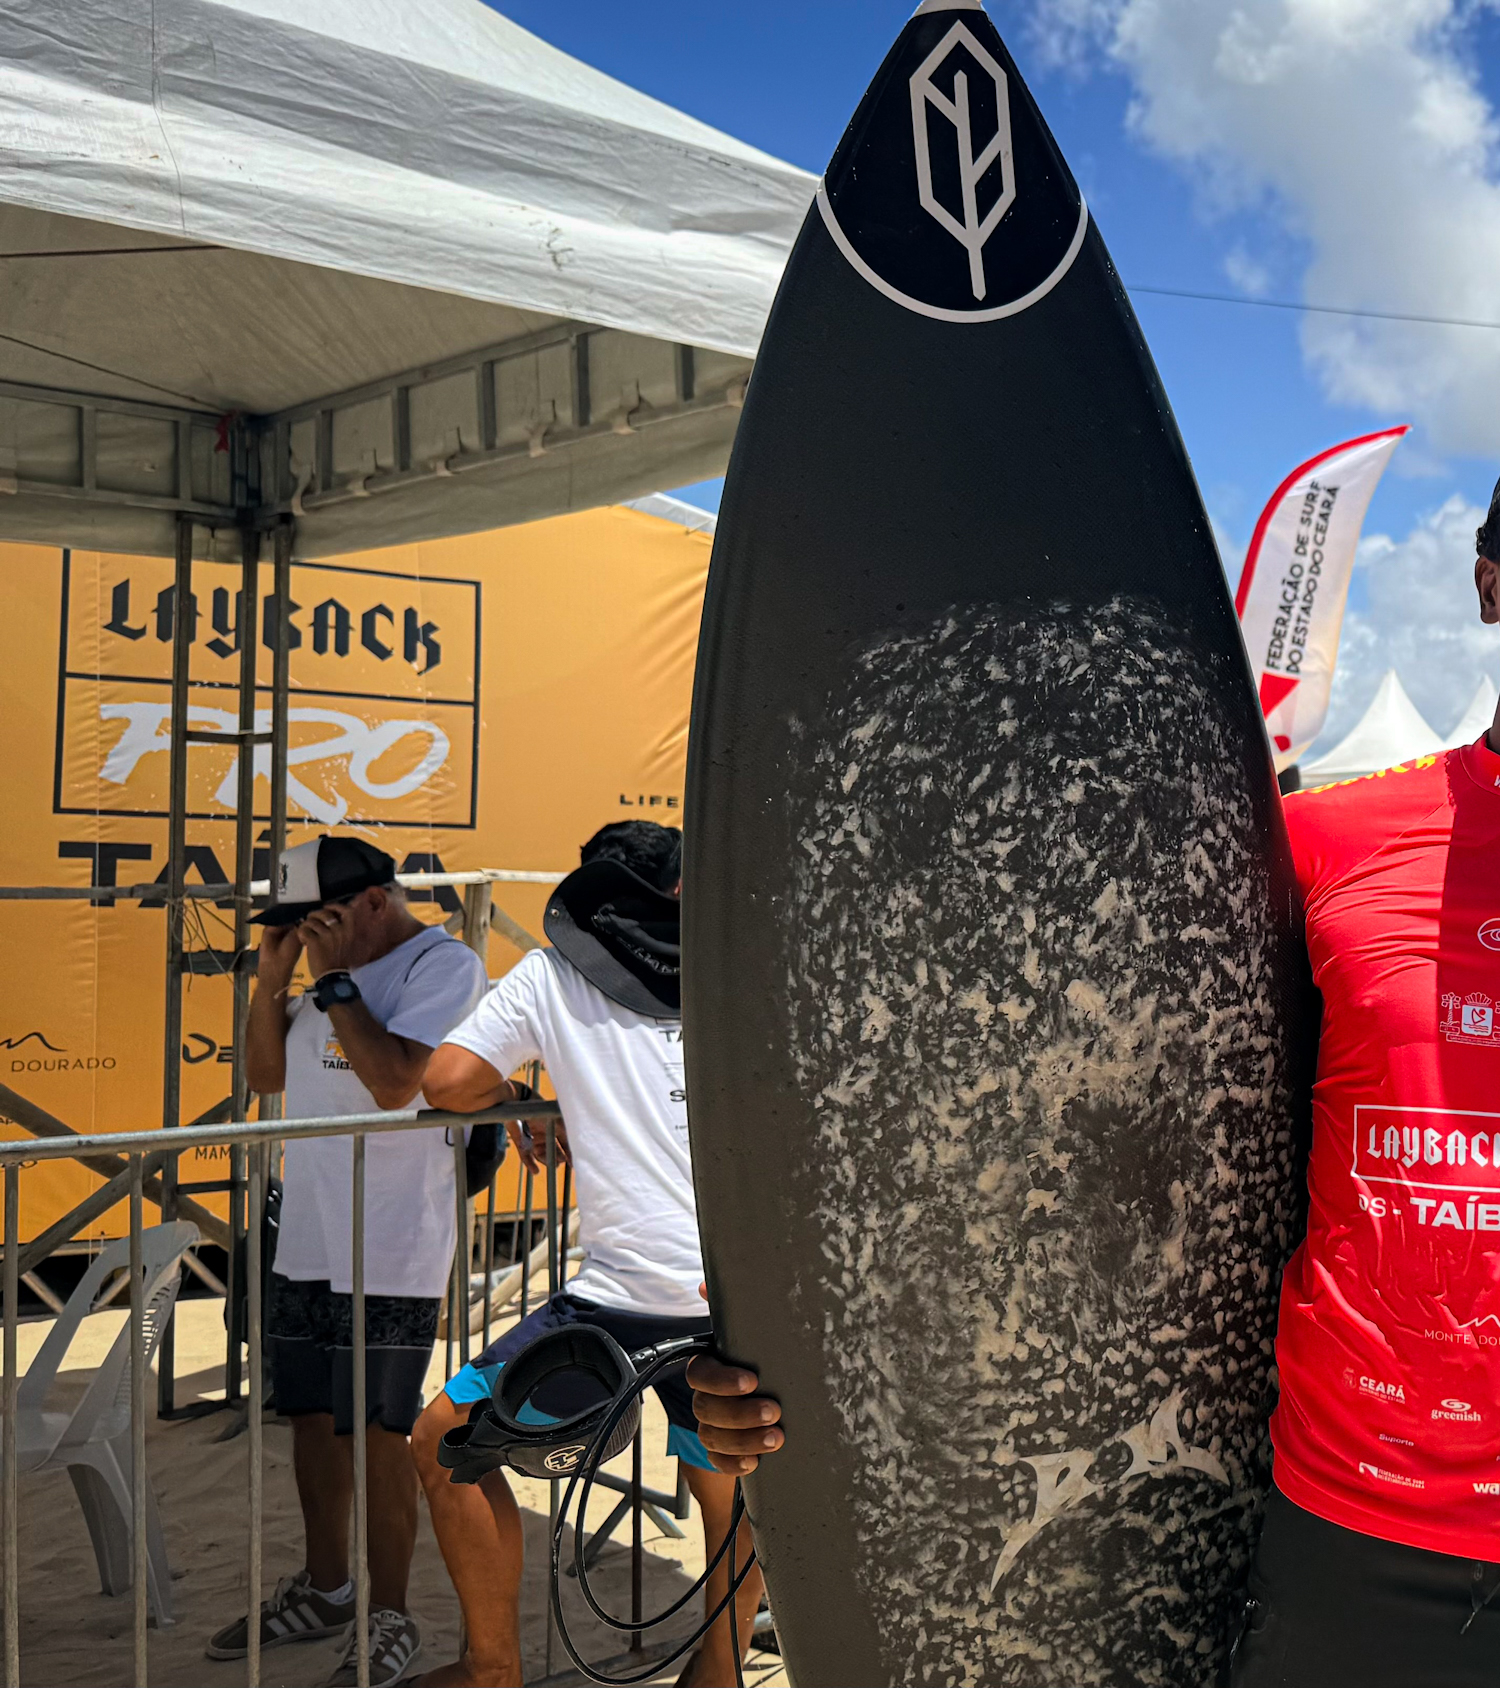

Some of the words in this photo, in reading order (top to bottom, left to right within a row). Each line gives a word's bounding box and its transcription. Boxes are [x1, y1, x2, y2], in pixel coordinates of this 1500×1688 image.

[1301, 480, 1321, 531] SURF
[1314, 484, 1340, 551] CEARÁ
[1294, 532, 1310, 556] DE
[1309, 551, 1324, 577] DO
[1266, 563, 1304, 670] FEDERAÇÃO
[1293, 577, 1318, 650] ESTADO
[103, 578, 442, 675] LAYBACK
[1287, 650, 1303, 674] DO
[98, 702, 451, 826] PRO
[11, 1057, 117, 1073] DOURADO
[1424, 1329, 1471, 1345] MONTE
[1359, 1376, 1406, 1401] CEARÁ
[1431, 1408, 1481, 1422] greenish
[1379, 1433, 1415, 1447] Suporte
